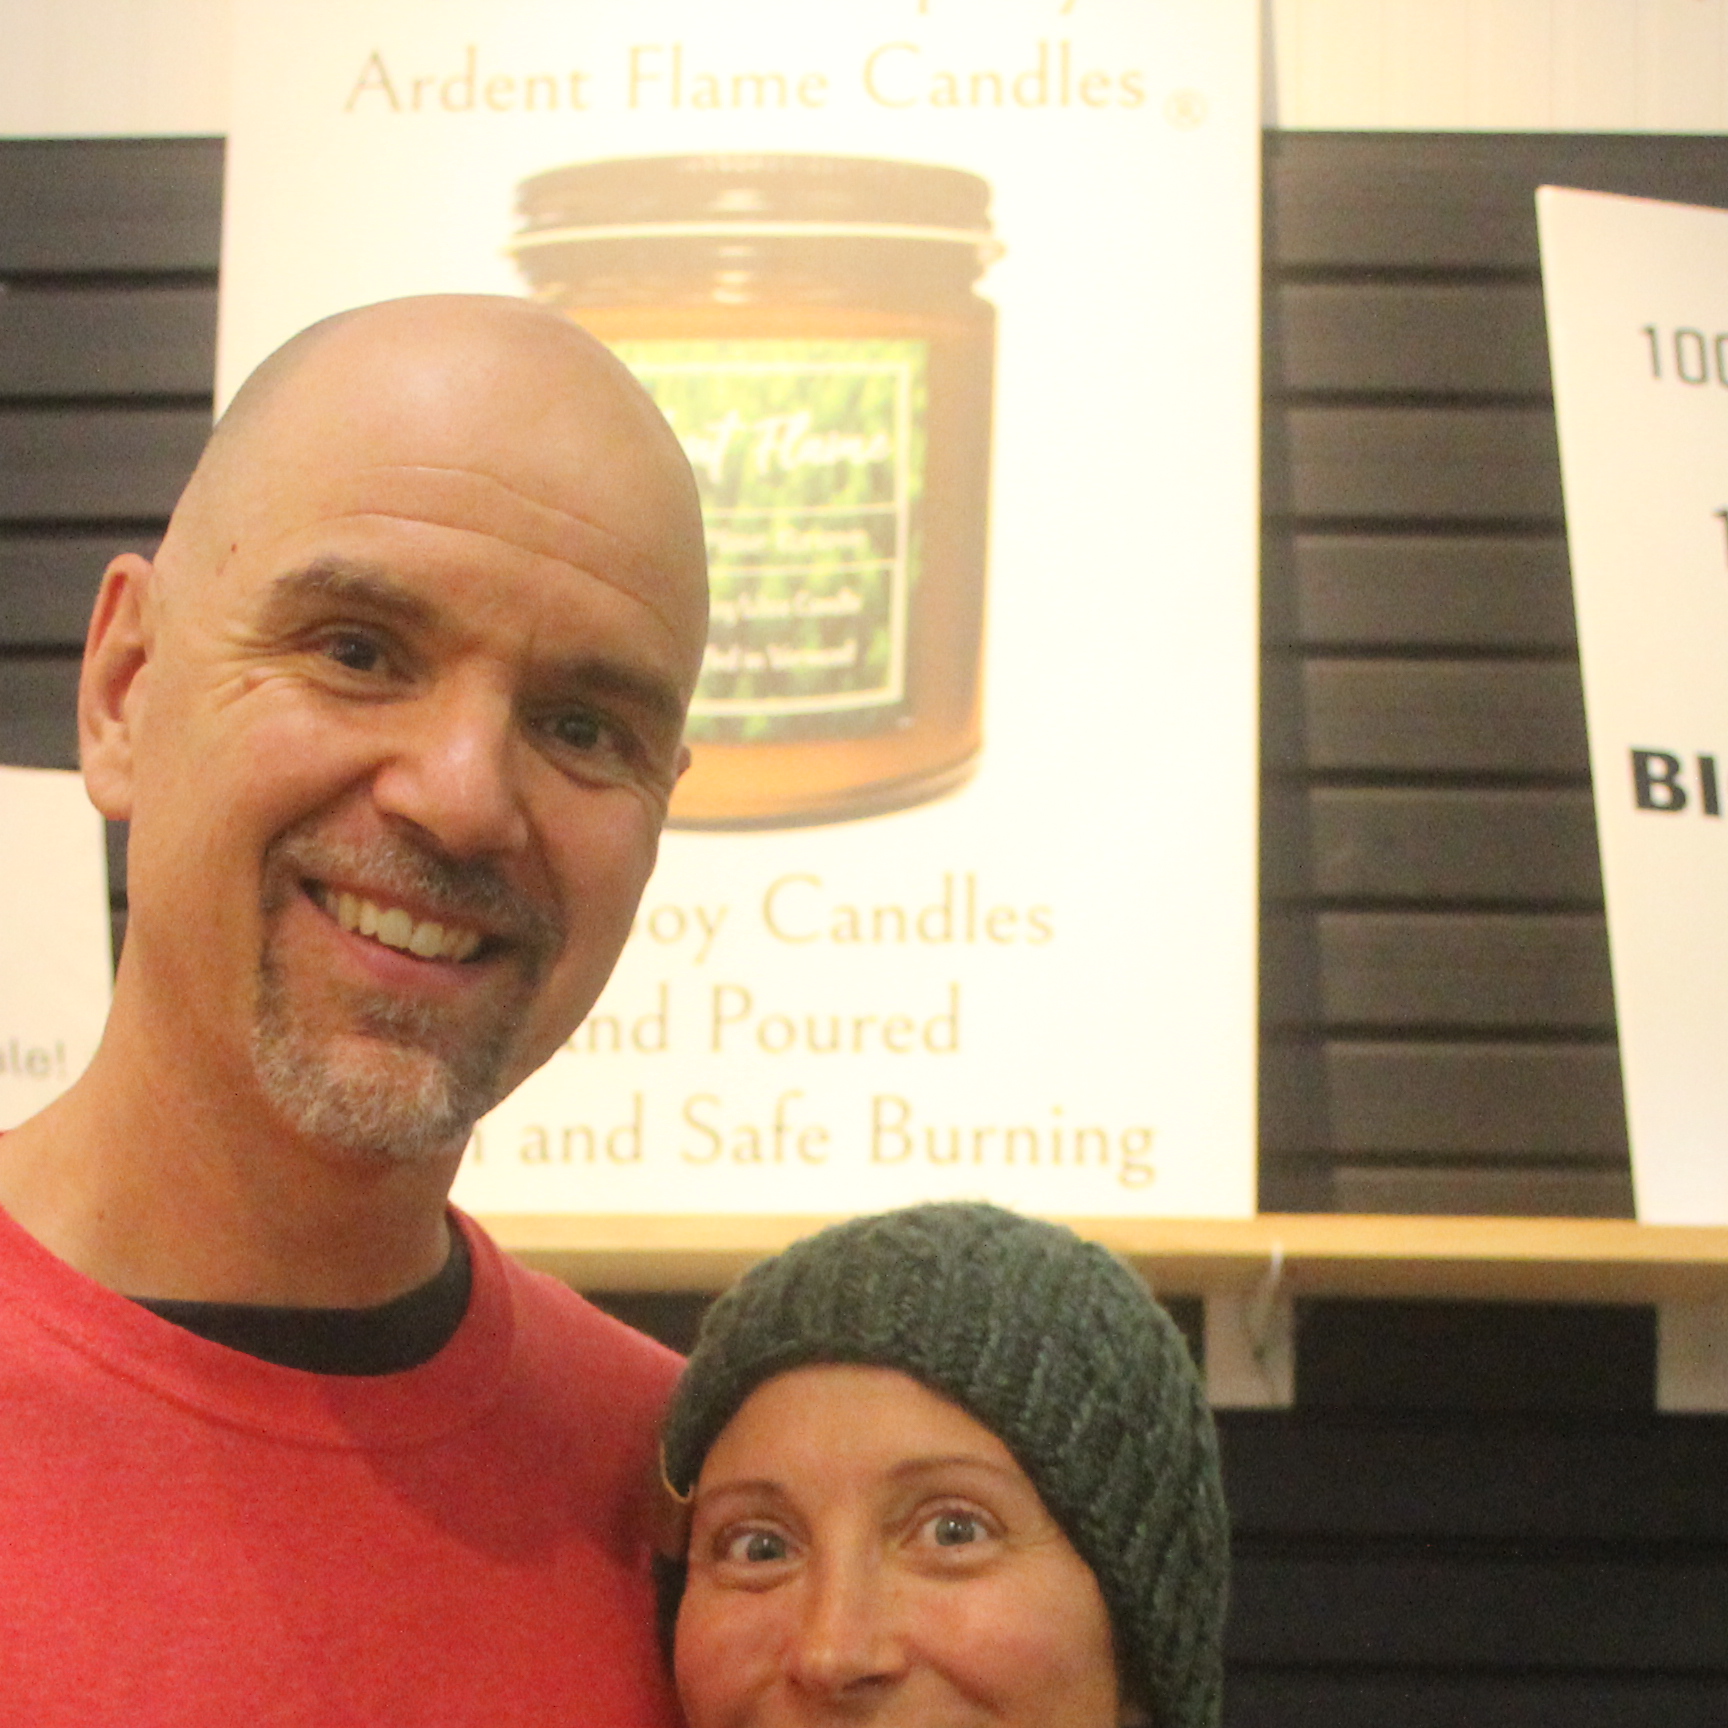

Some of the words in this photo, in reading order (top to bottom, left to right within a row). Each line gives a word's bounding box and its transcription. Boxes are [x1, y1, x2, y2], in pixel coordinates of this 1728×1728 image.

[342, 43, 593, 114] Ardent
[626, 40, 831, 110] Flame
[862, 38, 1148, 110] Candles
[633, 896, 730, 966] oy
[761, 871, 1057, 947] Candles
[568, 981, 670, 1056] nd
[708, 981, 963, 1057] Poured
[518, 1091, 646, 1168] and
[679, 1088, 833, 1168] Safe
[869, 1092, 1159, 1191] Burning
